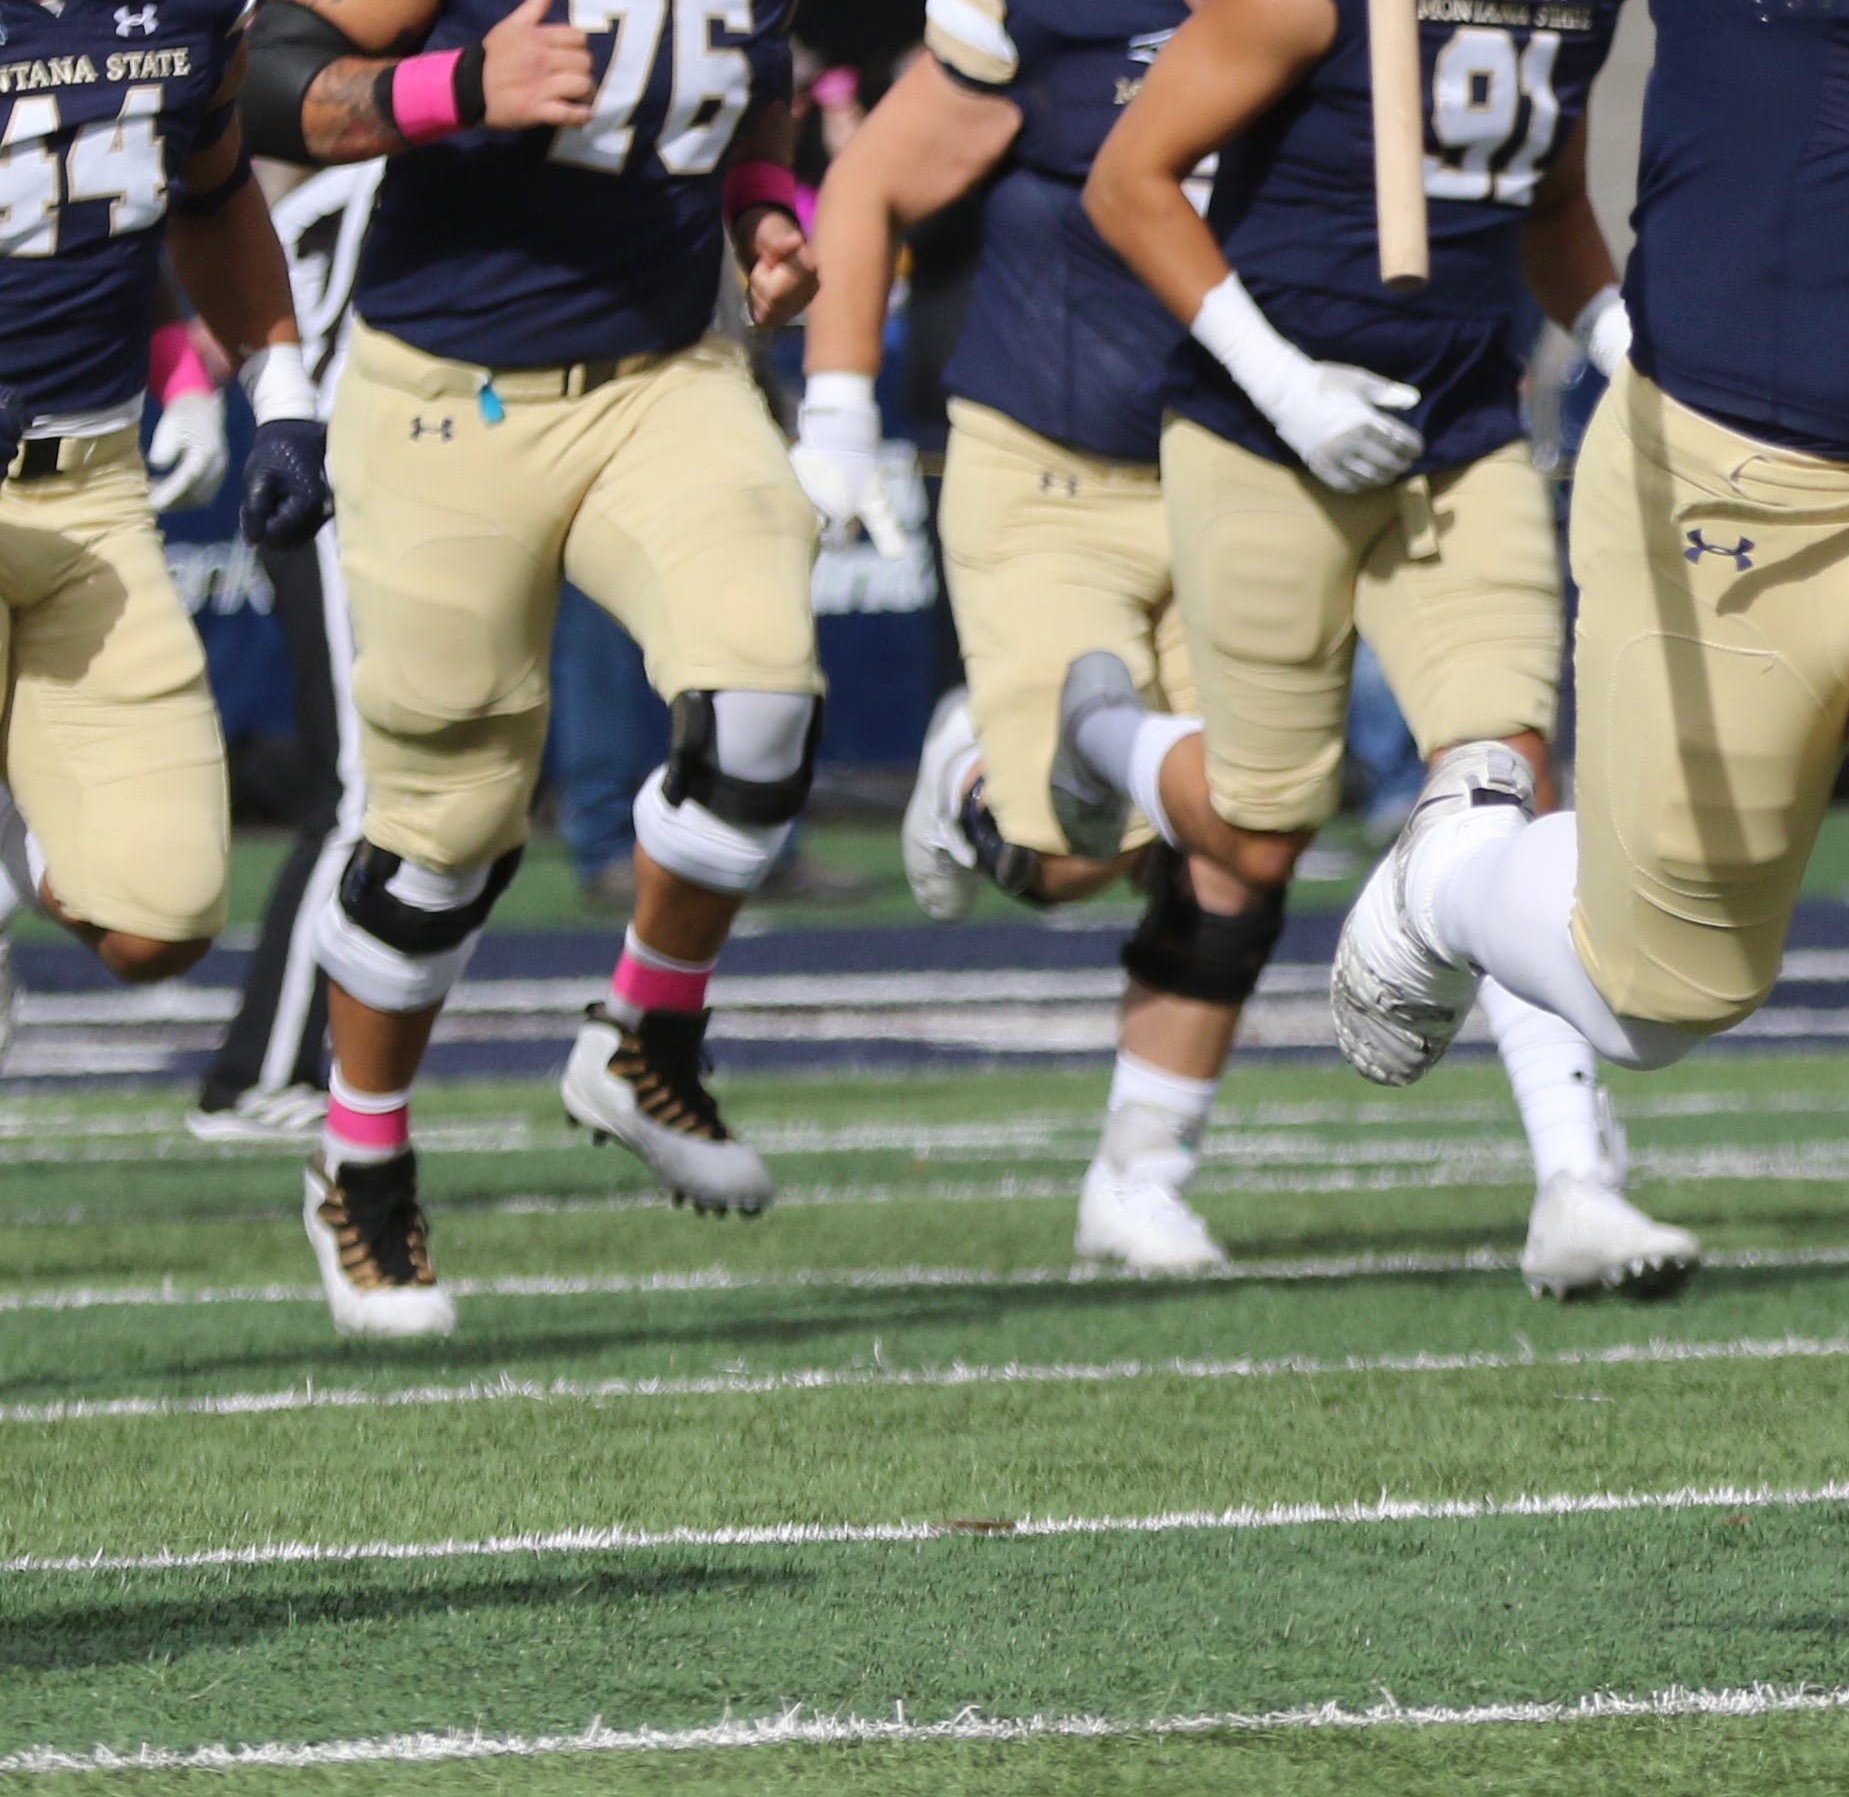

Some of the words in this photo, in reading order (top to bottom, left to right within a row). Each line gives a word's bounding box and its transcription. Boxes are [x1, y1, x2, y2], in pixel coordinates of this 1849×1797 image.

[105, 47, 192, 82] STATE
[1421, 25, 1563, 207] 91
[0, 82, 169, 259] 44
